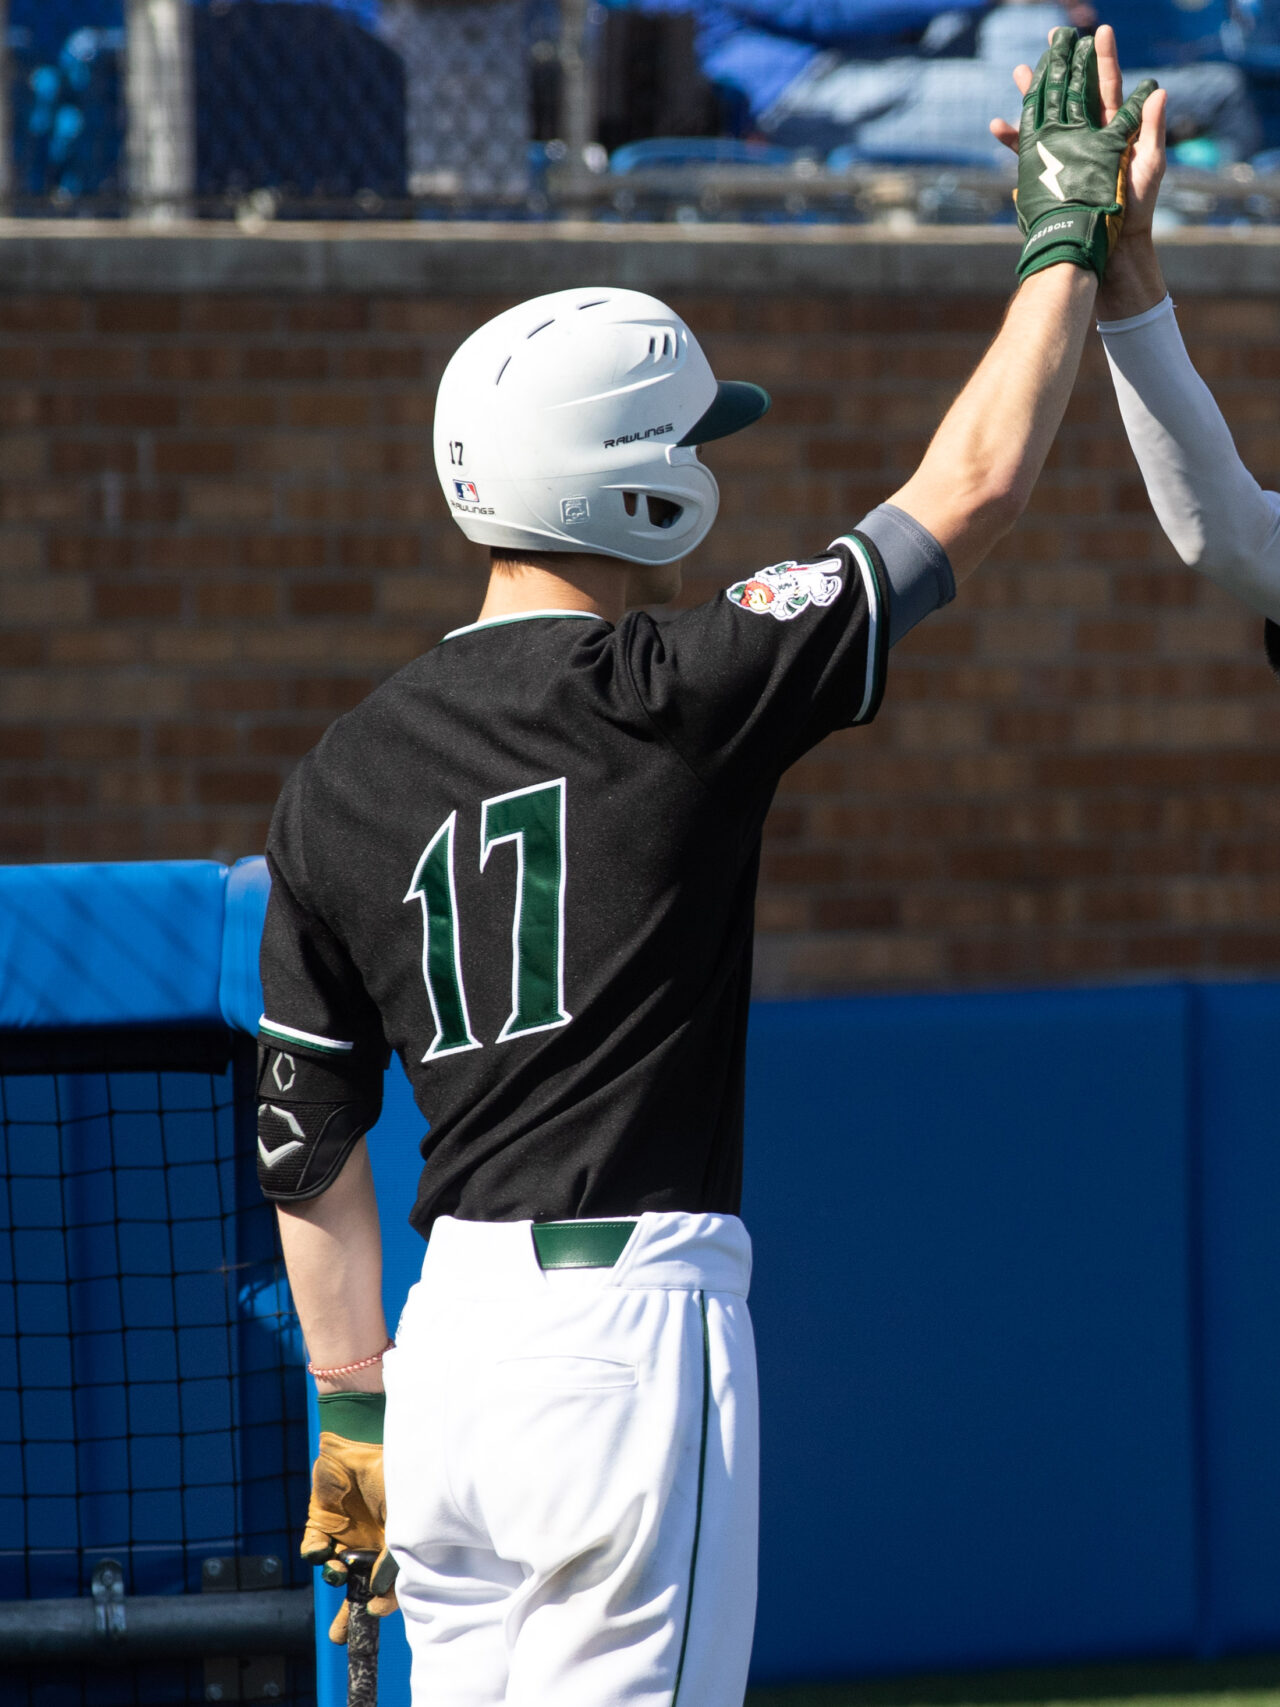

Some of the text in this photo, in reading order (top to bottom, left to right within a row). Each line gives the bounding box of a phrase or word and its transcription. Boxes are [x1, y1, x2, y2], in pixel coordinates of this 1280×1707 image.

[603, 423, 675, 449] RAWLINGS
[449, 438, 463, 466] 17
[402, 776, 574, 1063] 17
